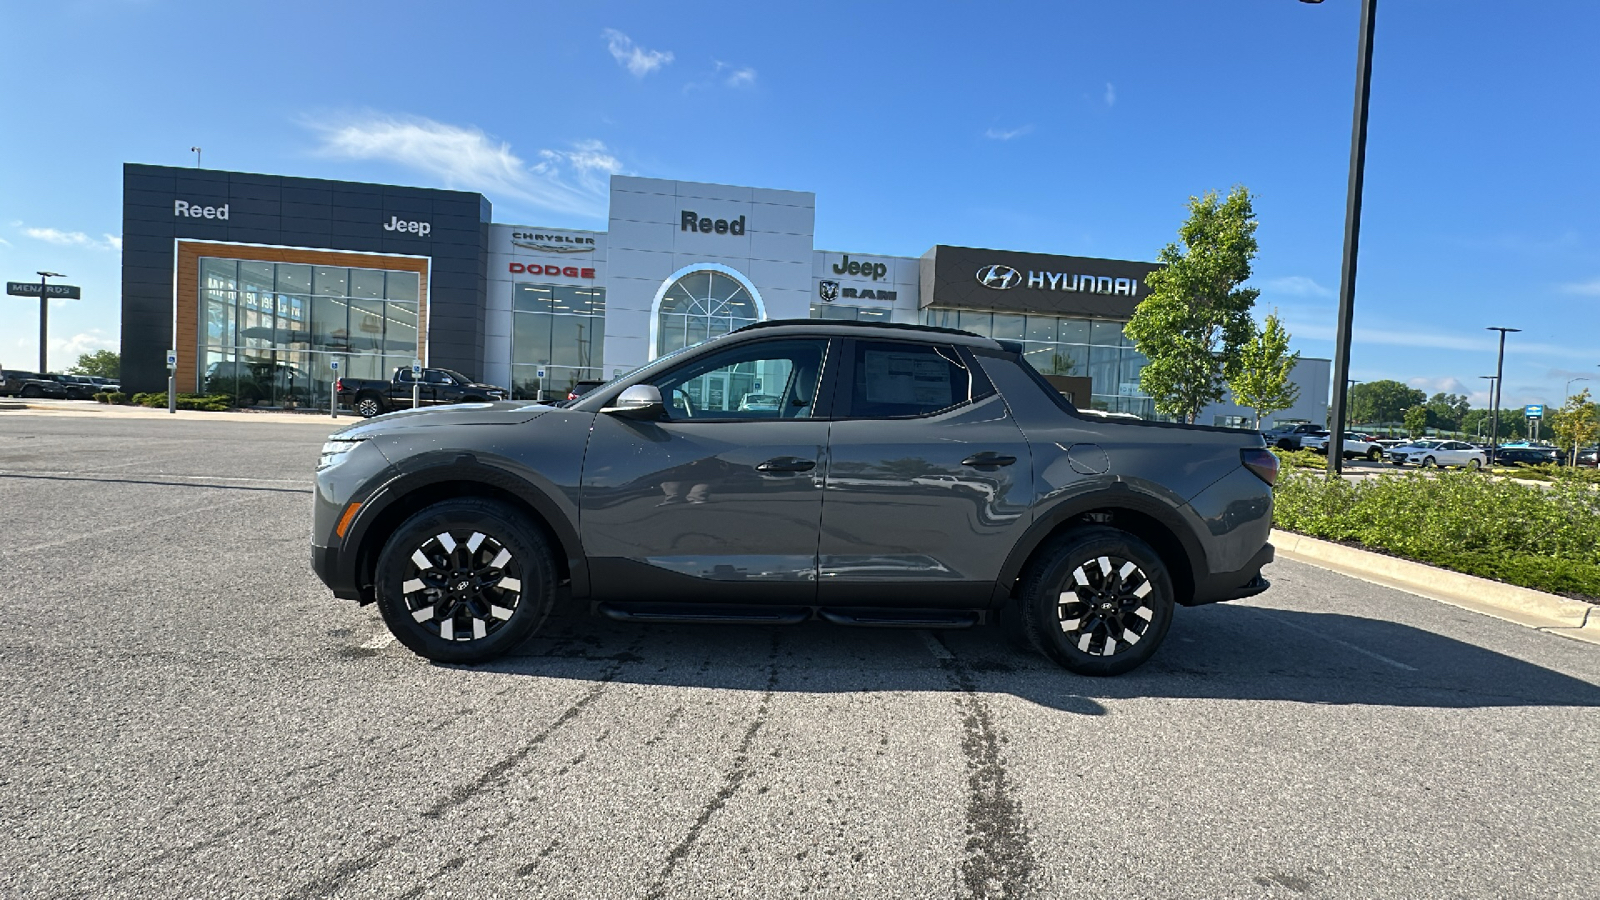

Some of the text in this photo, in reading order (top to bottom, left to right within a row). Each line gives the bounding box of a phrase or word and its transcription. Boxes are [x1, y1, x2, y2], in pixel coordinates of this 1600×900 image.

[174, 200, 229, 220] Reed
[383, 216, 431, 237] Jeep
[681, 210, 746, 236] Reed
[511, 232, 596, 245] CHRYSLER
[509, 262, 596, 279] DODGE
[833, 255, 887, 281] Jeep
[1027, 270, 1138, 297] HYUNDAI
[842, 288, 898, 301] RAM
